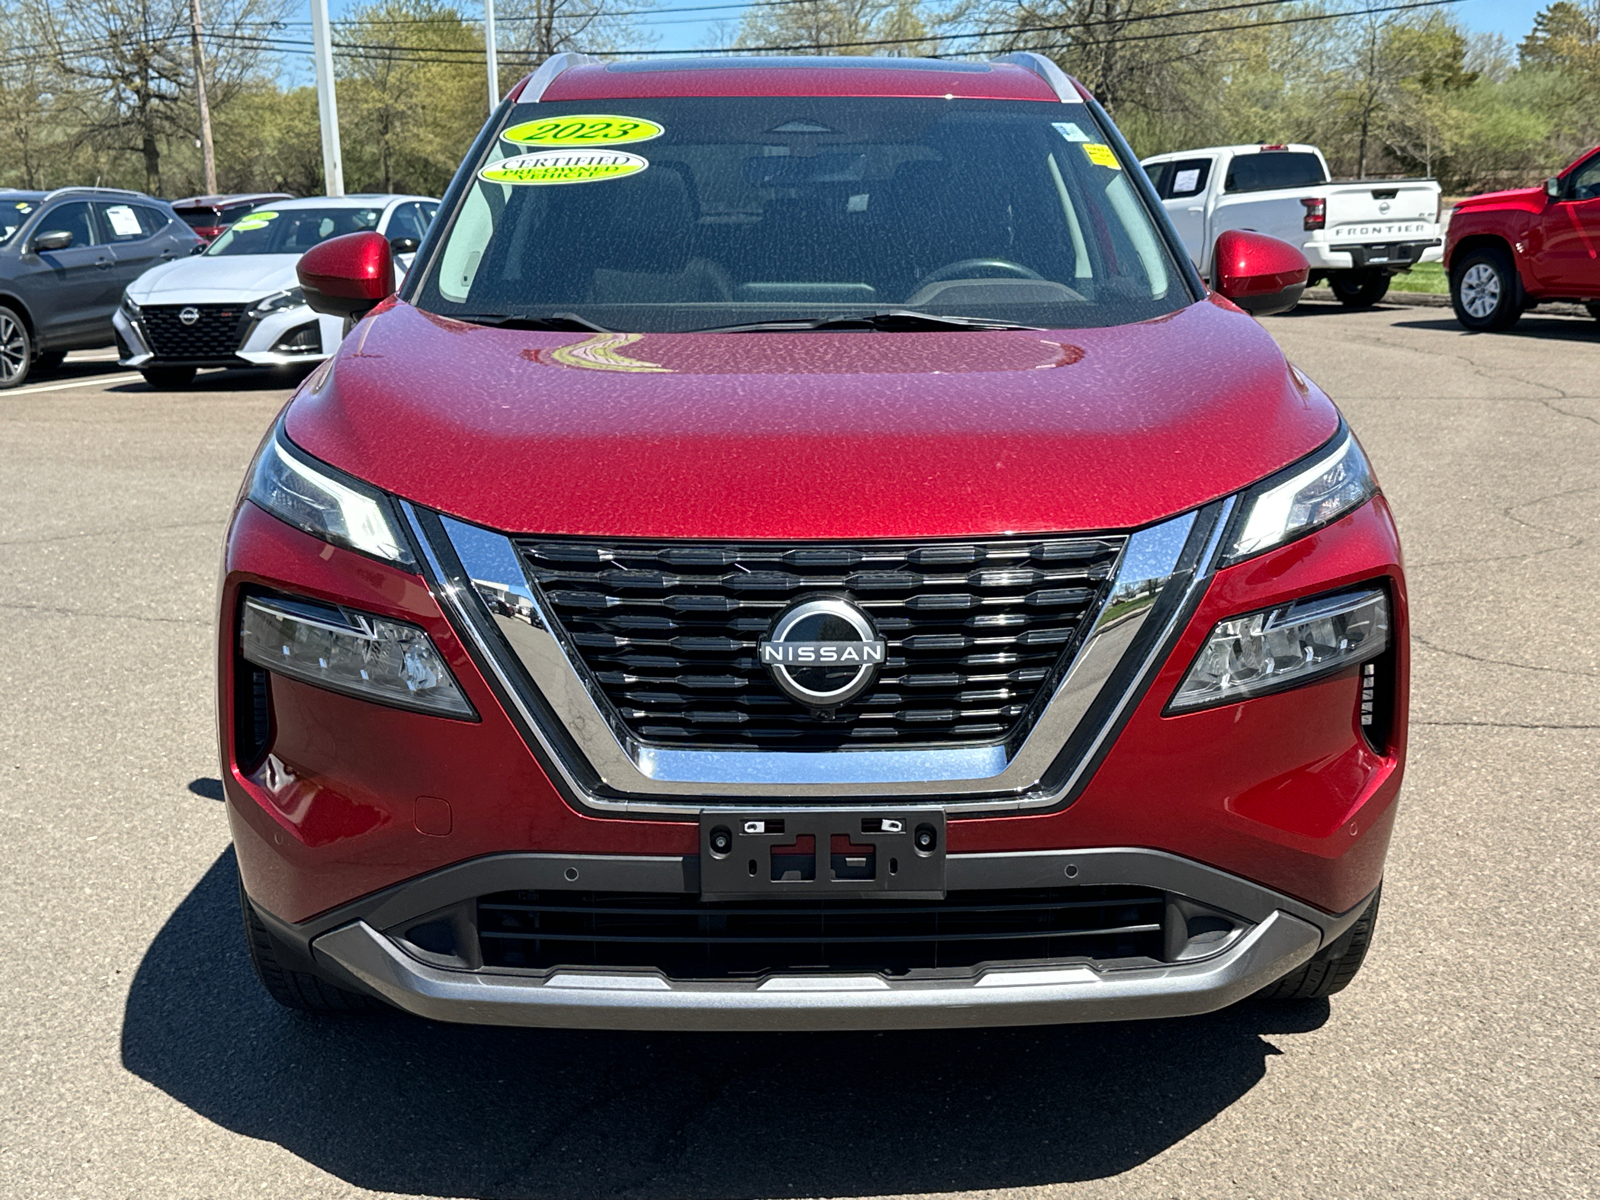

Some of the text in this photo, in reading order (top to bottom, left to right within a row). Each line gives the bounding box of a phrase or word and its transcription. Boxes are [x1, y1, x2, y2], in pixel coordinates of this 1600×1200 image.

[523, 123, 640, 141] 2023
[502, 156, 631, 170] CERTIFIED
[502, 166, 619, 177] PRE-OWNED
[517, 171, 600, 180] VEHICLE
[1335, 224, 1425, 236] FRONTIER
[765, 645, 881, 661] NISSAN
